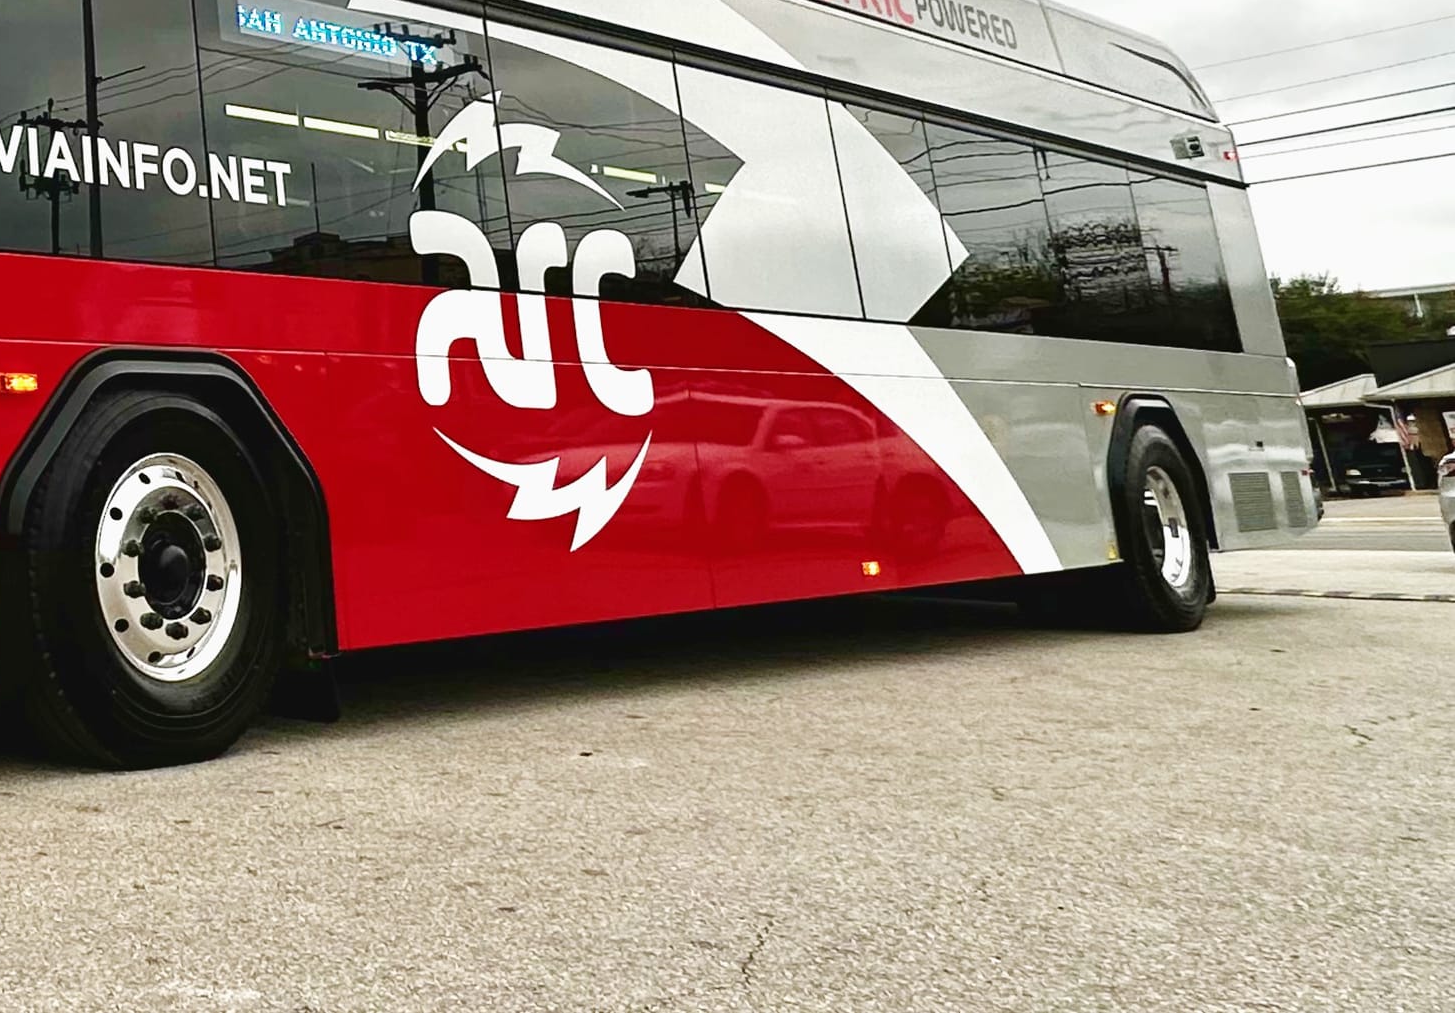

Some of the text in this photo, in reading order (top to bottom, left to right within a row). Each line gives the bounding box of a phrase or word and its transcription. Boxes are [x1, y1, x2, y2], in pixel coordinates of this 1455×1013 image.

[292, 16, 397, 57] ANTONIO
[406, 40, 438, 65] TX
[409, 210, 655, 416] arc
